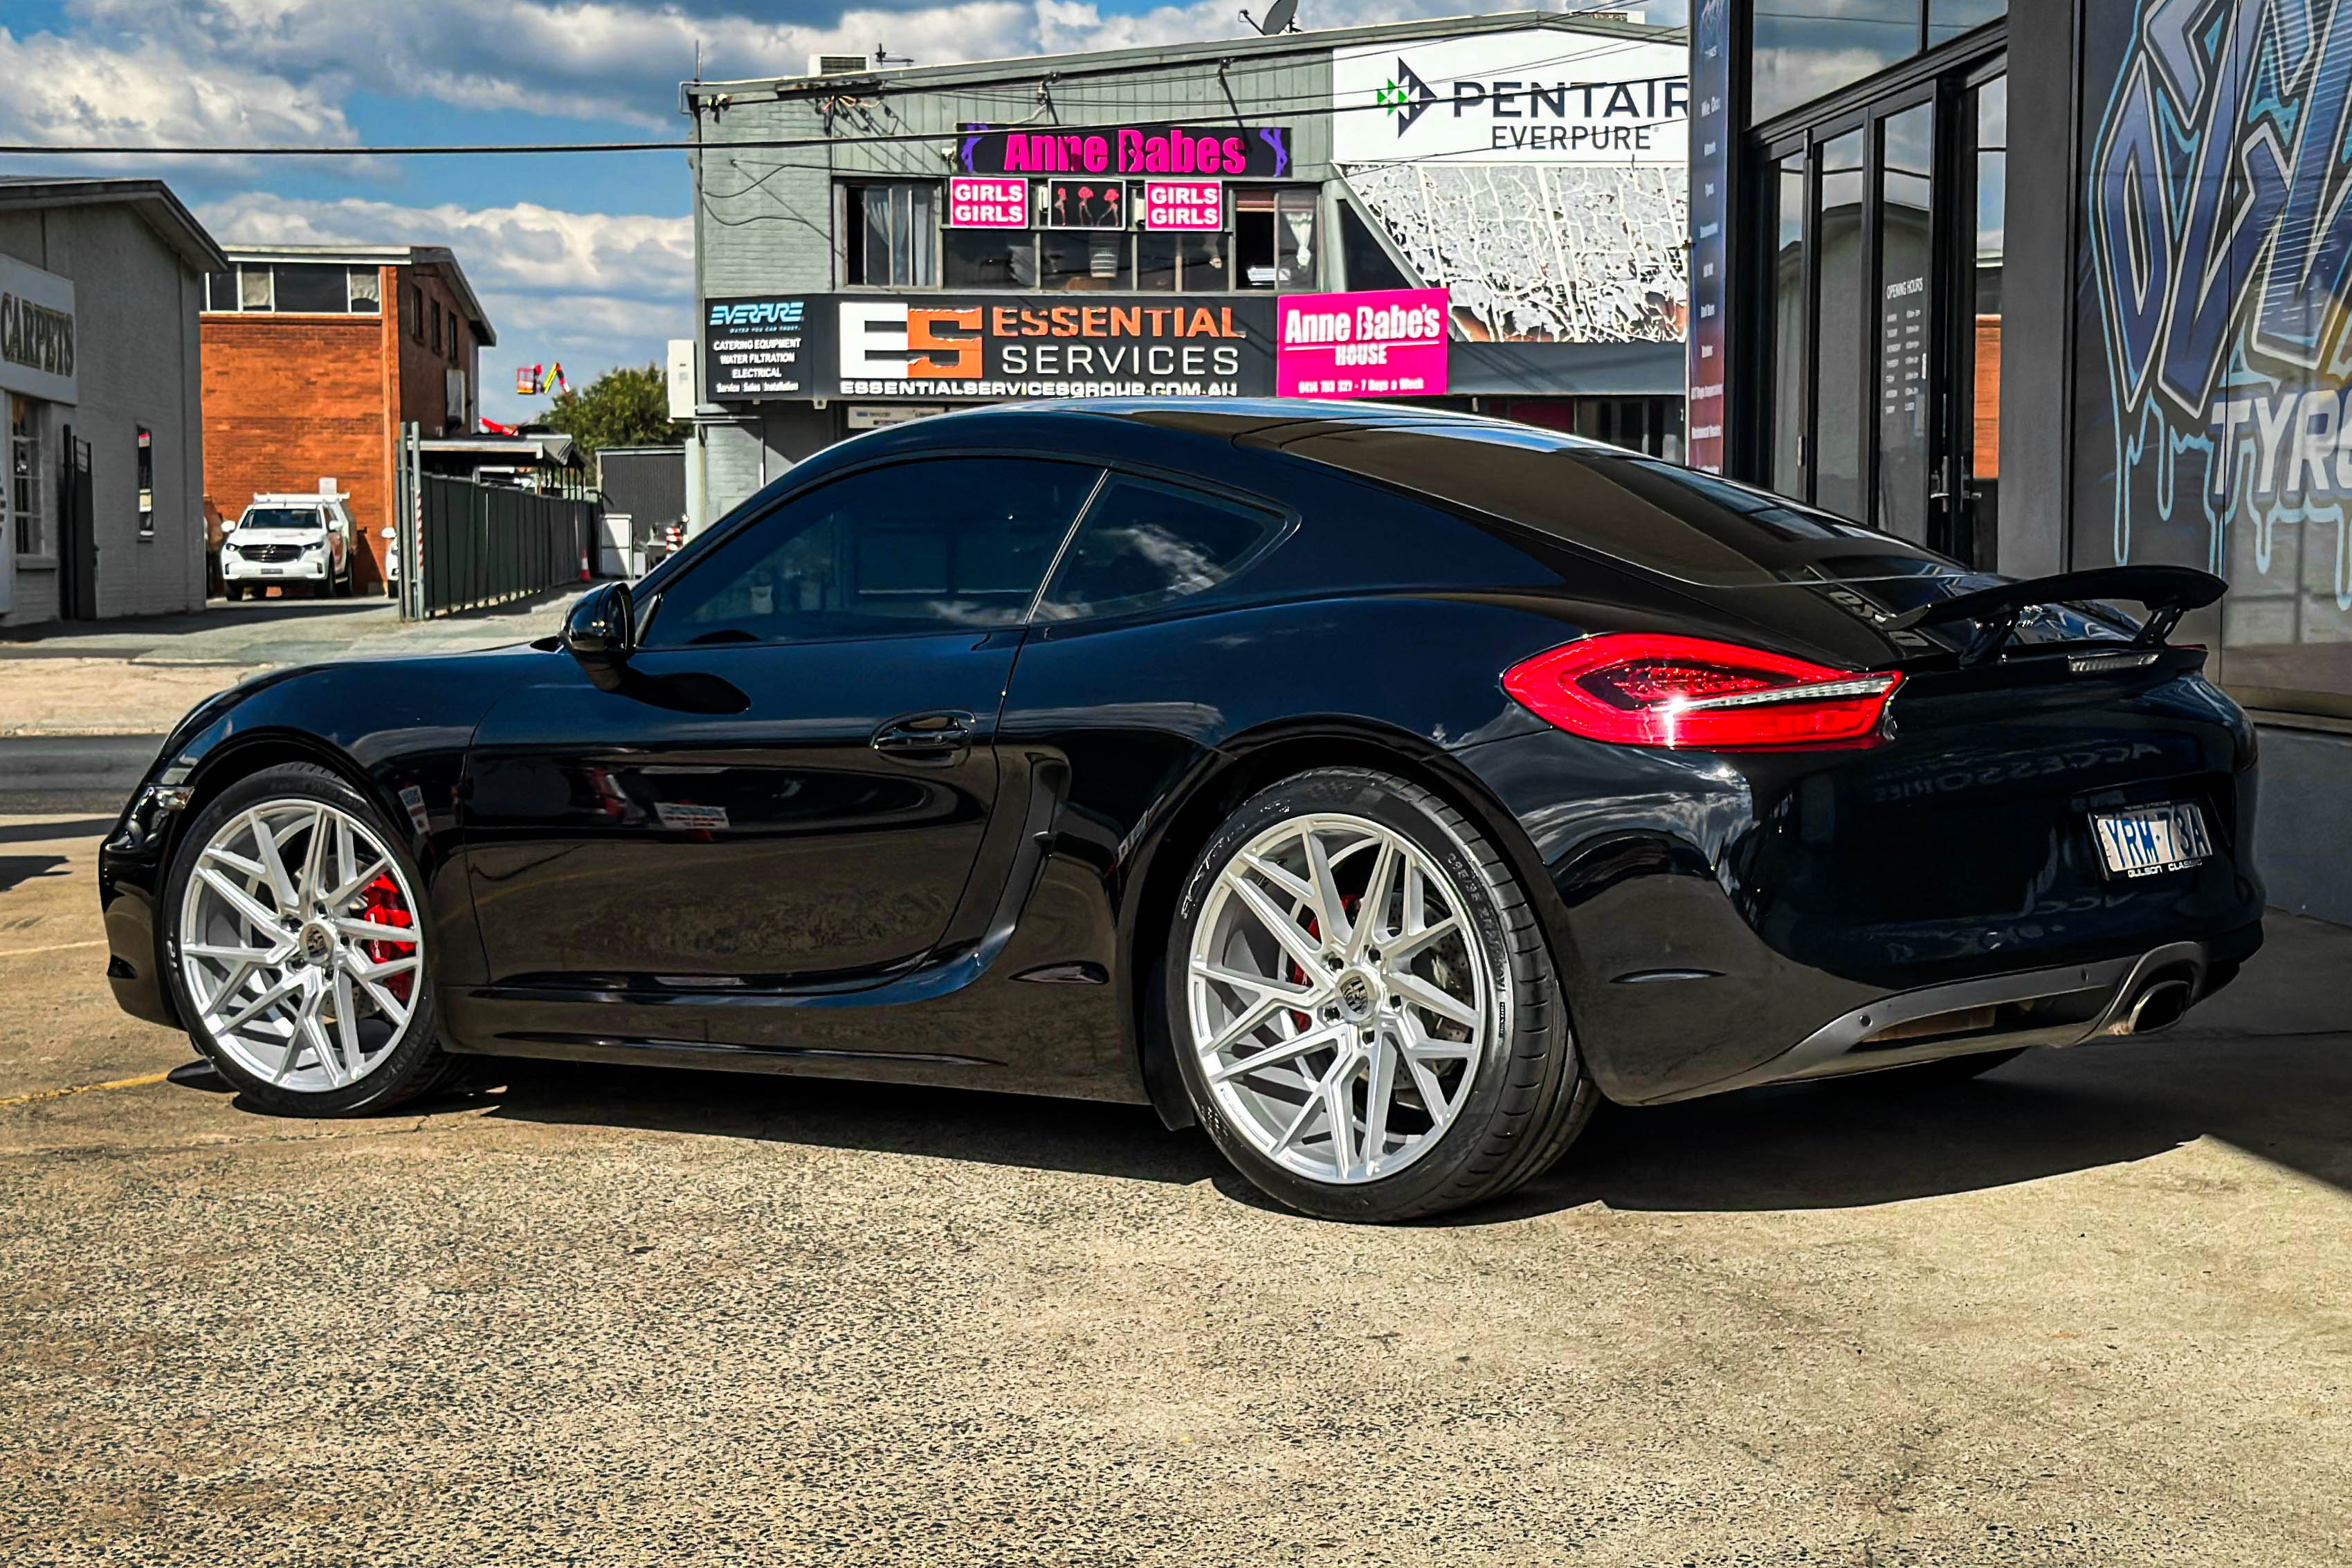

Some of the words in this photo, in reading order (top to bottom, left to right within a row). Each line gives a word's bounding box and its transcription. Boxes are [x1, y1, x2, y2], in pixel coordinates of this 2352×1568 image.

[1453, 81, 1688, 118] PENTAIR
[1491, 125, 1651, 149] EVERPURE
[1003, 134, 1107, 172] Anne
[1118, 129, 1246, 174] Babes
[954, 185, 1023, 203] GIRLS
[1151, 187, 1218, 205] GIRLS
[954, 205, 1023, 223] GIRLS
[1151, 207, 1218, 225] GIRLS
[1886, 281, 1906, 300] OPENING
[1907, 277, 1923, 292] HOURS
[709, 302, 804, 325] EVERPURE
[993, 307, 1246, 338] ESSENTIAL
[1285, 309, 1351, 343] Anne
[1356, 304, 1440, 340] Babe's
[1, 291, 74, 377] CARPETS
[713, 340, 754, 351] CATERING
[754, 338, 801, 349] EQUIPMENT
[720, 354, 748, 364] WATER
[749, 352, 795, 363] FILTRATION
[1003, 345, 1239, 375] SERVICES
[1335, 345, 1387, 365] HOUSE
[732, 367, 782, 379] ELECTRICAL
[716, 383, 740, 393] Service
[743, 382, 761, 392] Sales
[763, 381, 799, 392] Installation
